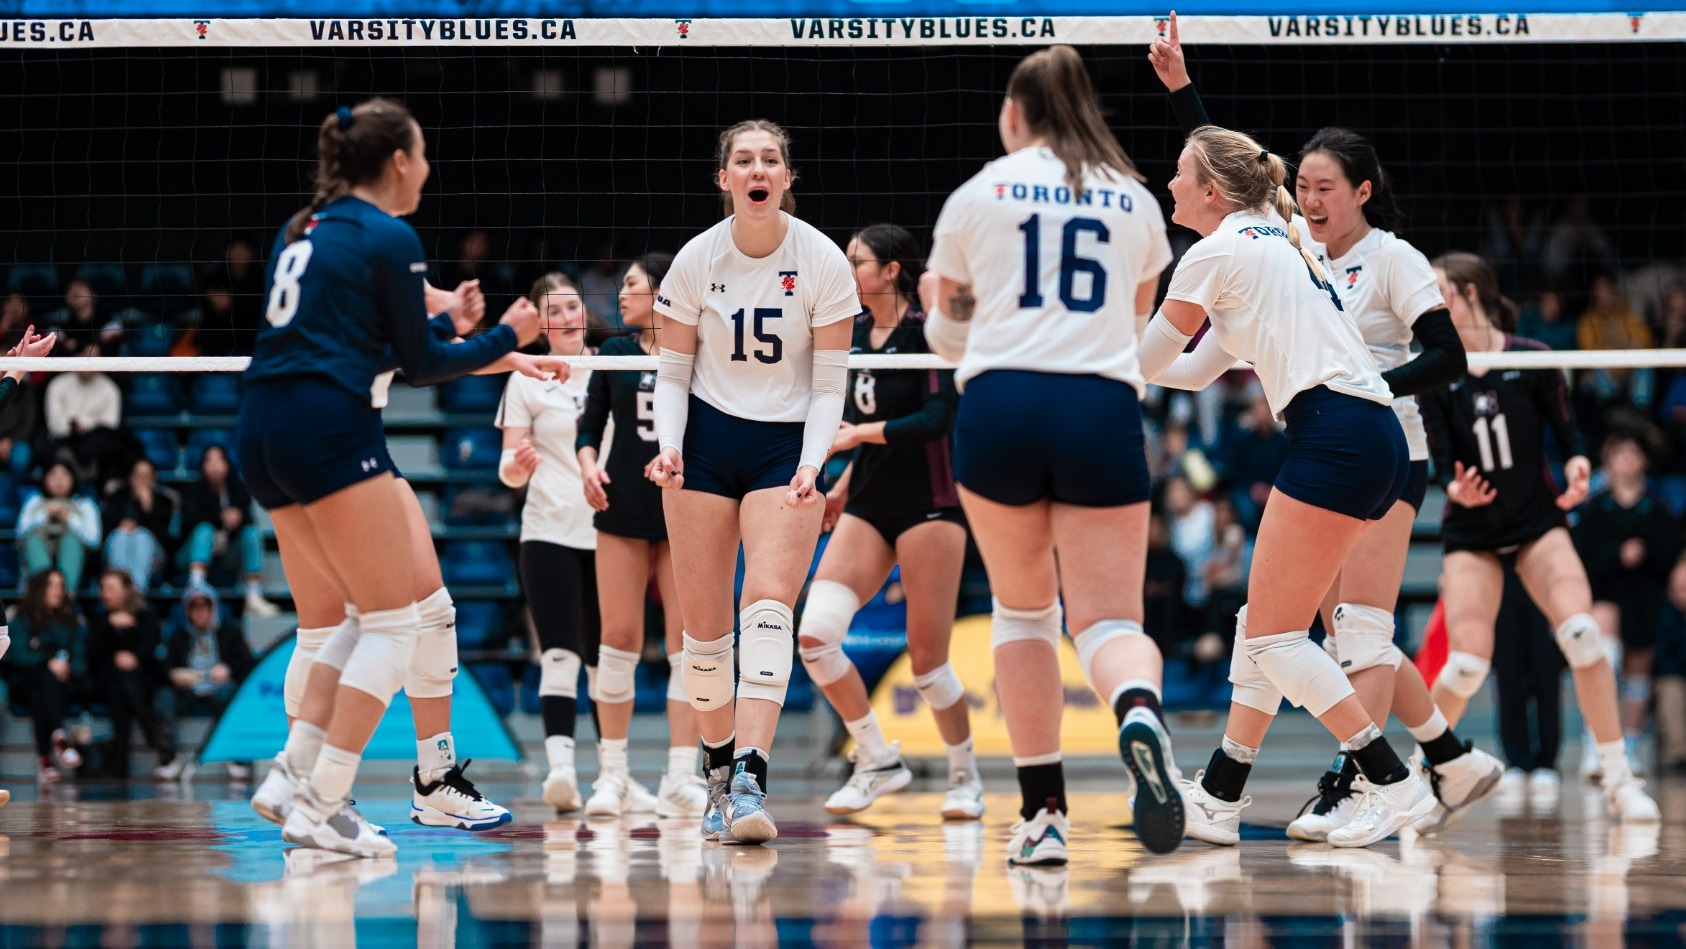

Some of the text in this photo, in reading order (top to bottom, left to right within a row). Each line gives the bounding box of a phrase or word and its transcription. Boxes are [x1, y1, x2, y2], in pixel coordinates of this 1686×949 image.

[310, 19, 577, 41] VARSITYBLUES.CA
[791, 17, 1056, 39] VARSITYBLUES.CA
[1268, 14, 1530, 37] VARSITYBLUES.CA
[994, 183, 1133, 213] TORONTO
[265, 239, 314, 329] 8
[1017, 213, 1111, 314] 16
[731, 307, 783, 364] 15
[636, 391, 659, 442] 5
[1472, 413, 1514, 473] 11
